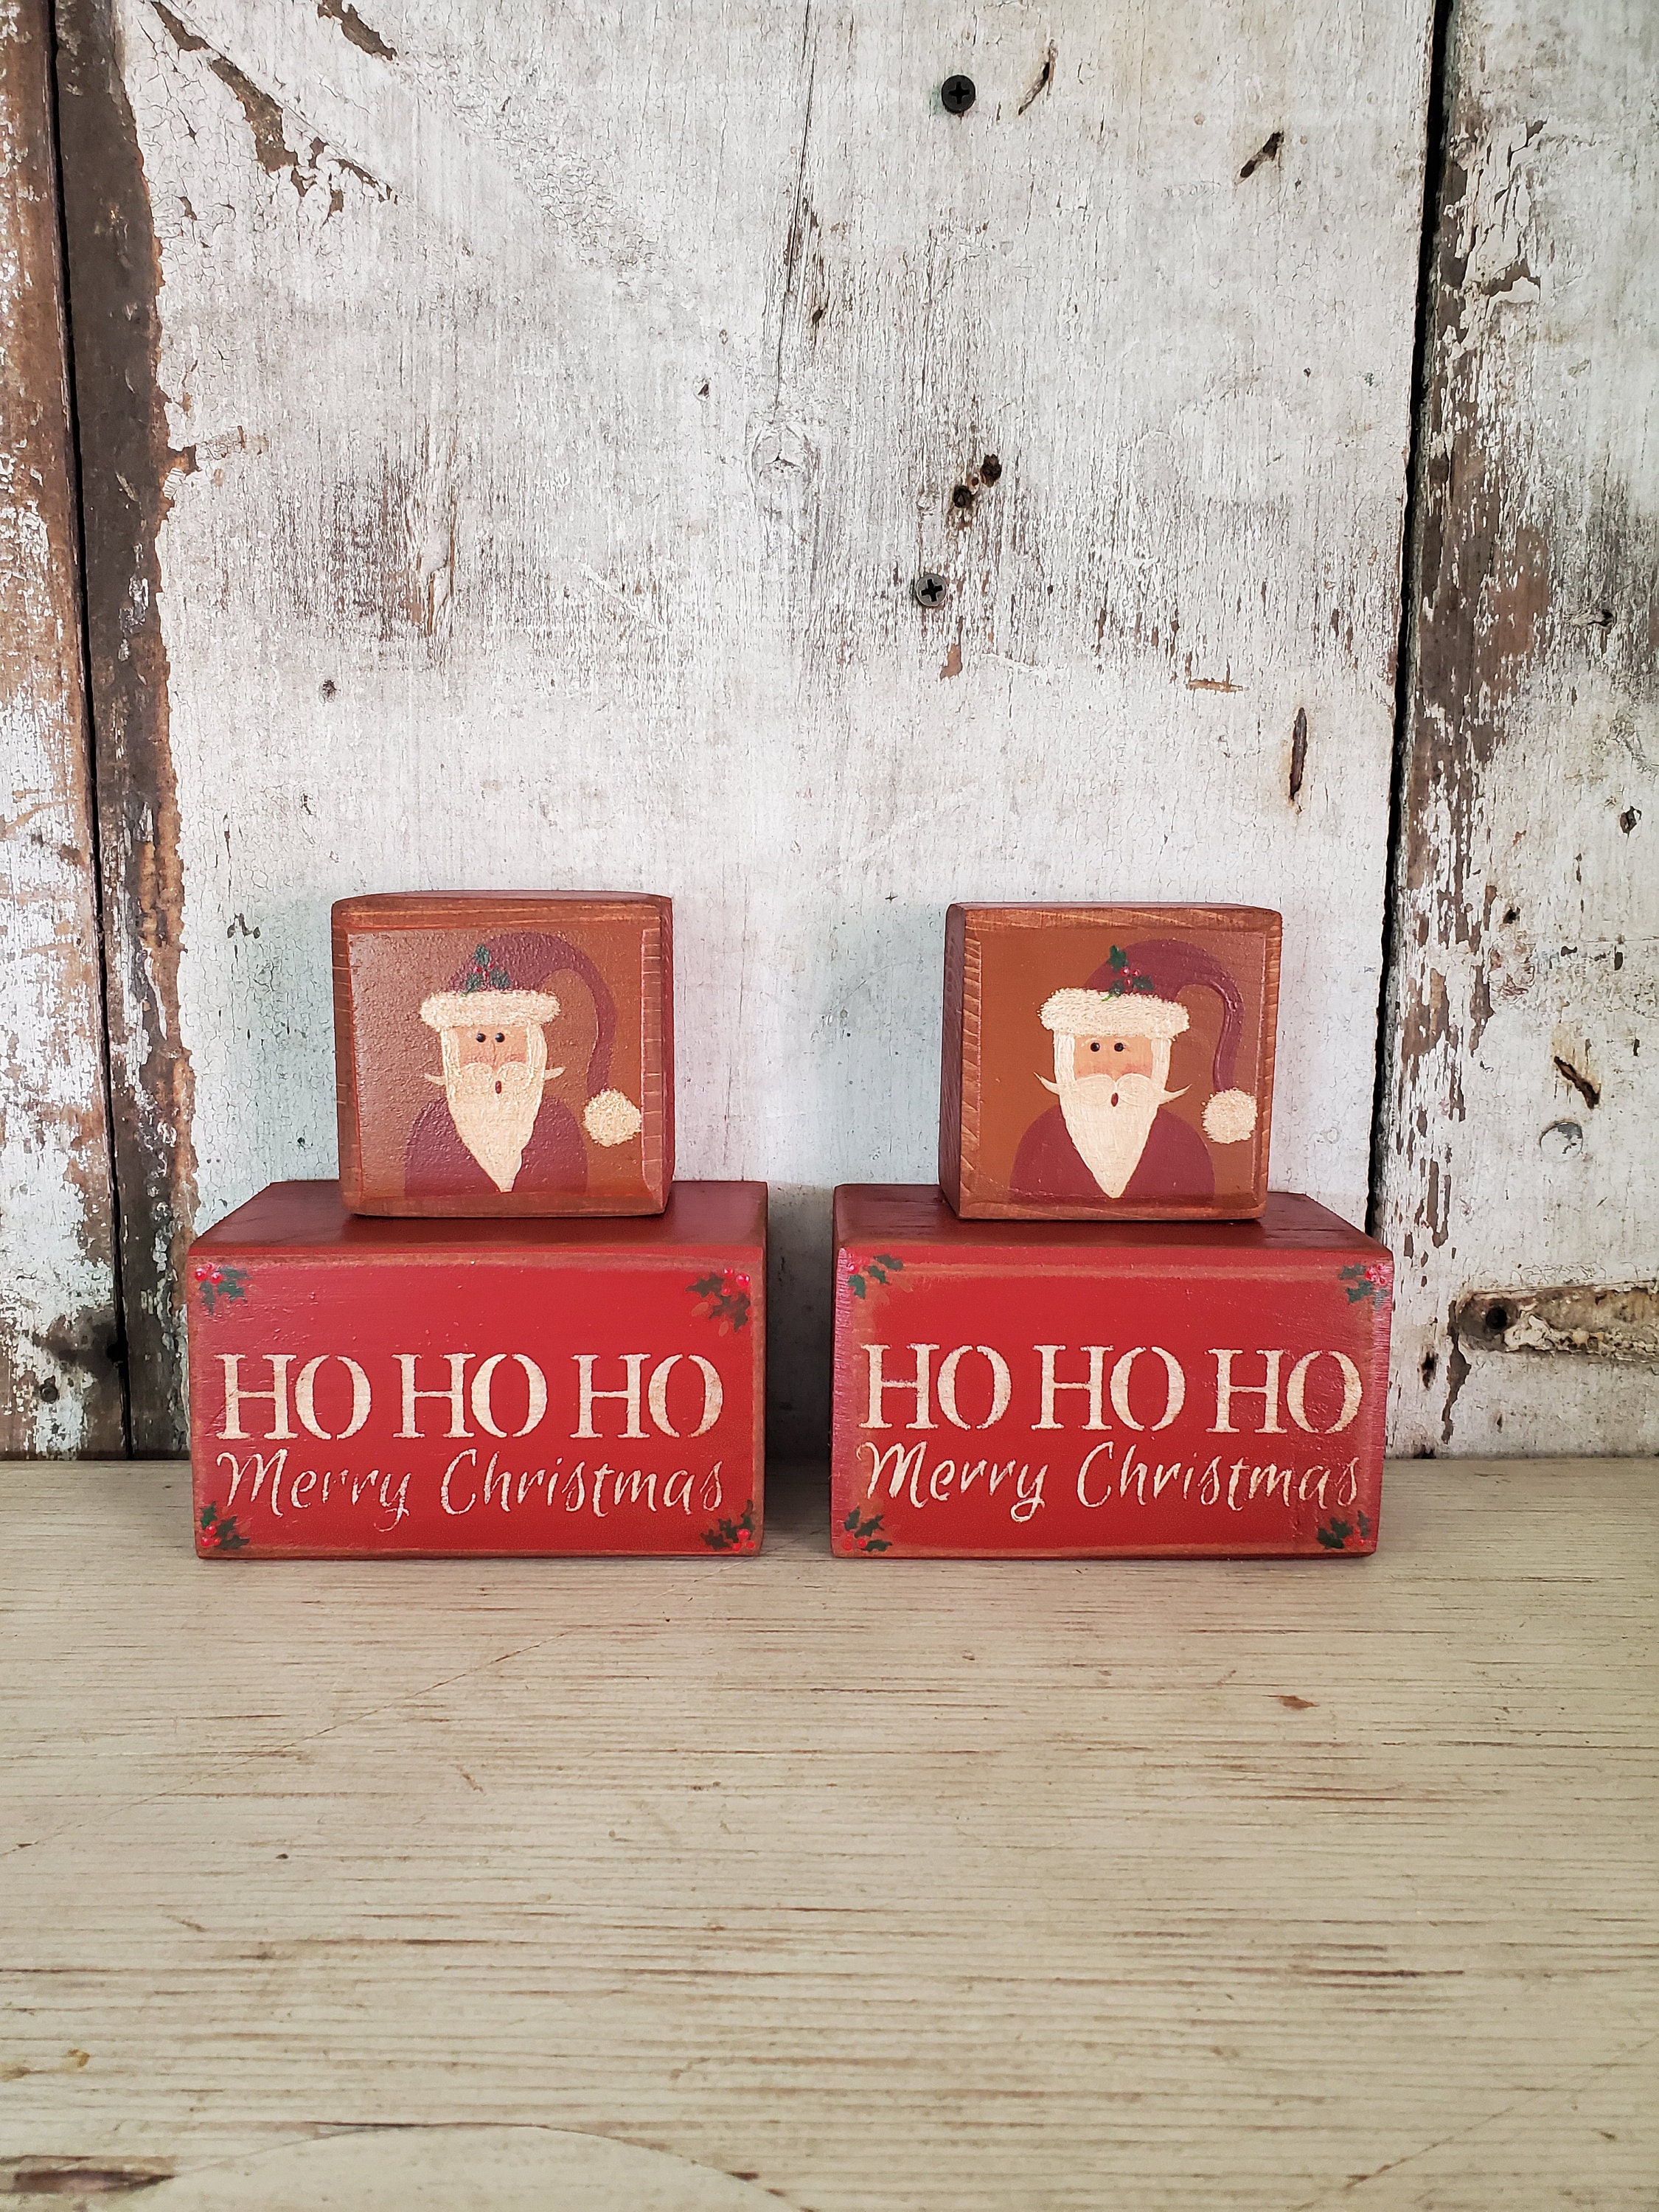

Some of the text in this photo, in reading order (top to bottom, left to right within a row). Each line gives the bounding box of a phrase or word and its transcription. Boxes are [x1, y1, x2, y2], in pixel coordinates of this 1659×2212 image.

[214, 1353, 724, 1441] HO HO HO
[860, 1343, 1365, 1434] HO HO HO
[216, 1448, 723, 1533] Merry Christmas
[857, 1441, 1361, 1524] Merry Christmas
